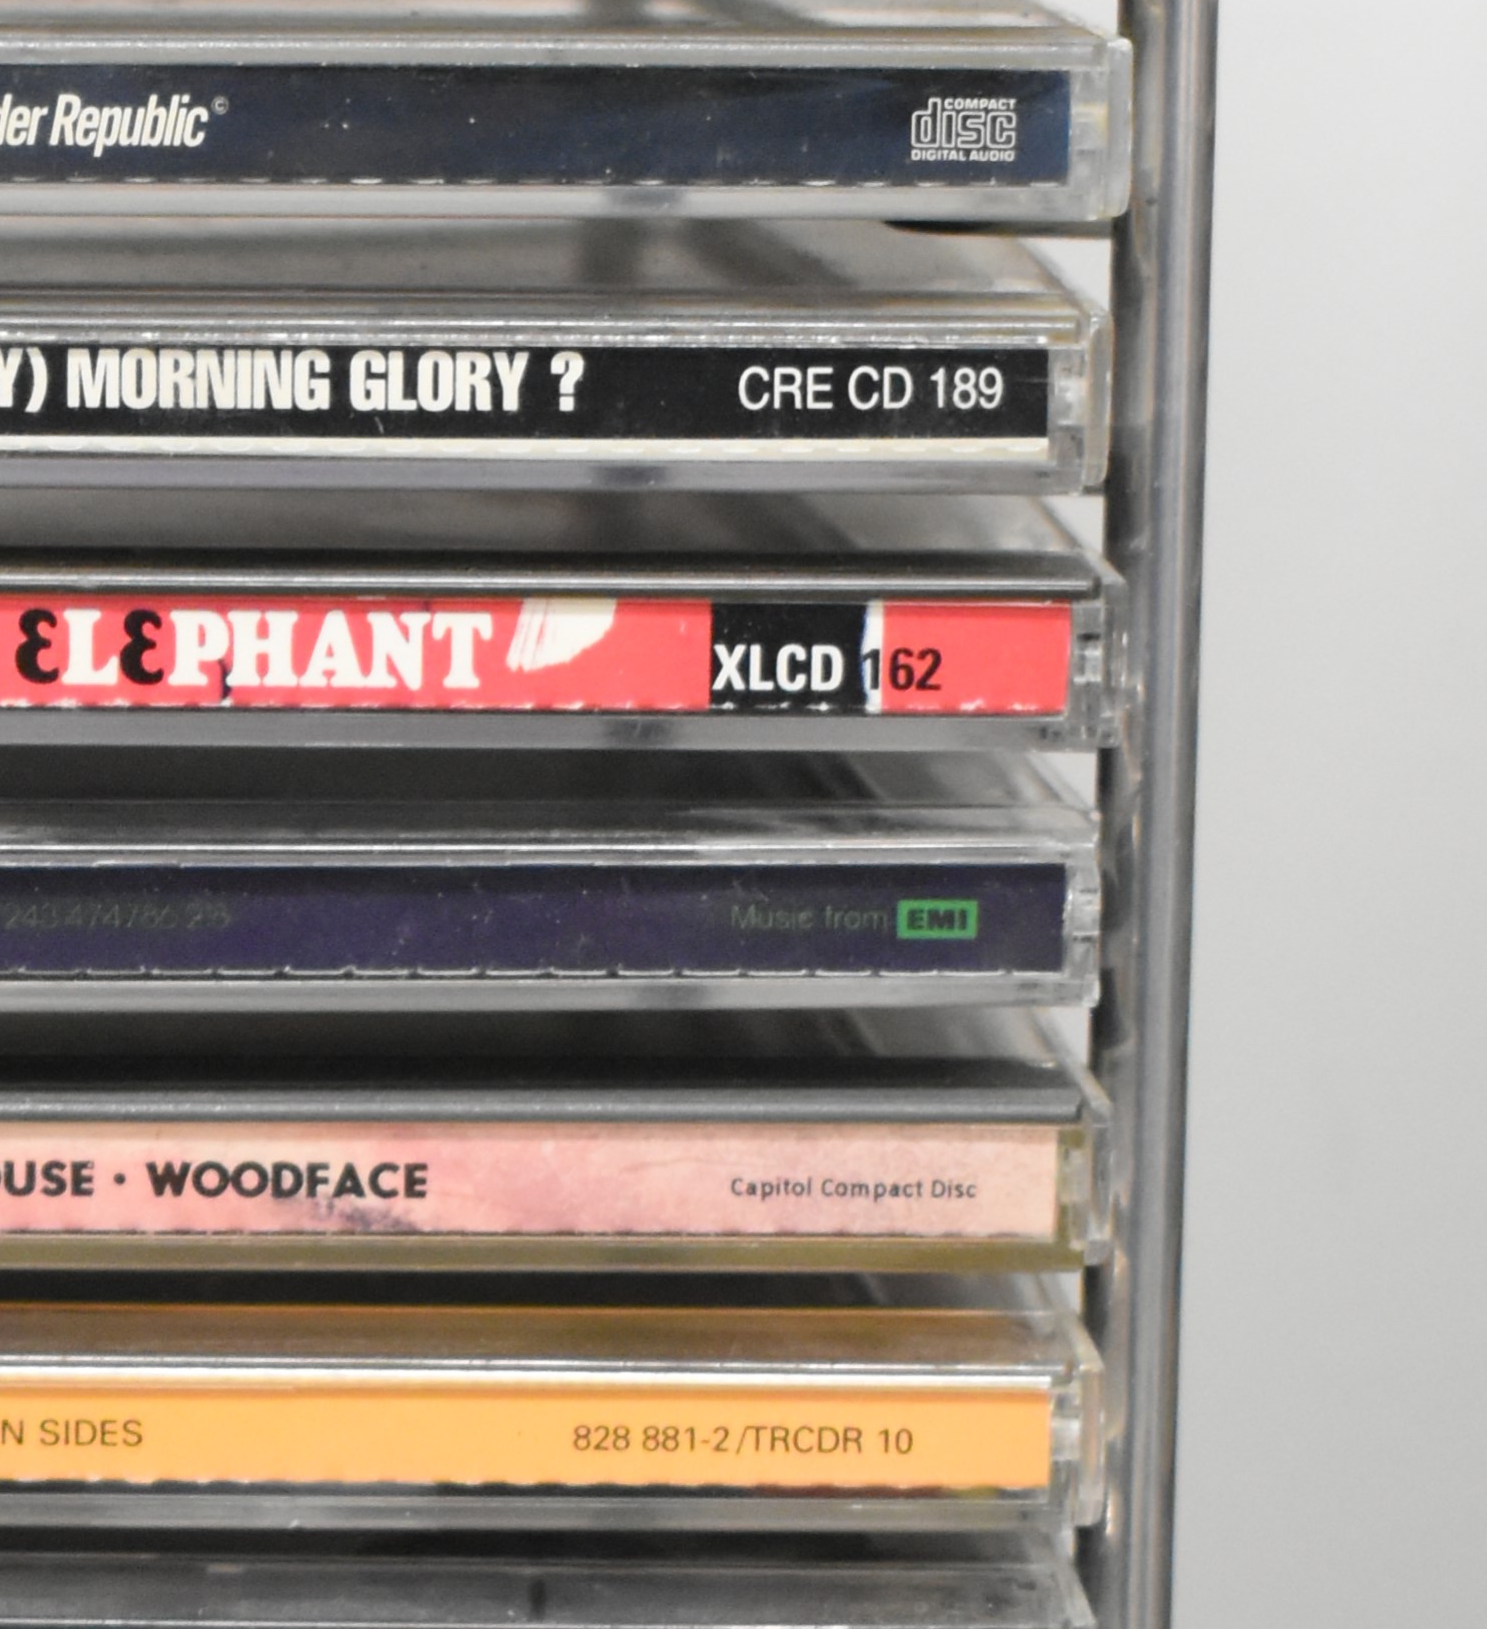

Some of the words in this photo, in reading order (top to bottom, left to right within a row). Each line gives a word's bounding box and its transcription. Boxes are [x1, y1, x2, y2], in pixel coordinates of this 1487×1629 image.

[944, 98, 1017, 110] COMPACT
[911, 97, 1016, 149] disc
[911, 150, 966, 161] DIGITAL
[969, 150, 1015, 161] AUDIO
[67, 349, 330, 411] MORNING
[350, 350, 527, 412] GLORY
[550, 350, 585, 412] ?
[738, 366, 834, 411] CRE
[848, 366, 913, 411] CD
[930, 366, 1004, 412] 189
[711, 642, 843, 691] XLCD
[861, 647, 943, 692] 162
[730, 904, 815, 930] Music
[825, 905, 888, 930] from
[907, 909, 968, 931] EMI
[147, 1161, 428, 1201] WOODFACE
[730, 1176, 811, 1203] Capitol
[819, 1176, 924, 1204] Compact
[932, 1178, 976, 1200] Disc
[38, 1419, 143, 1447] SIDES
[573, 1425, 631, 1453] 828
[879, 1428, 914, 1456] 10
